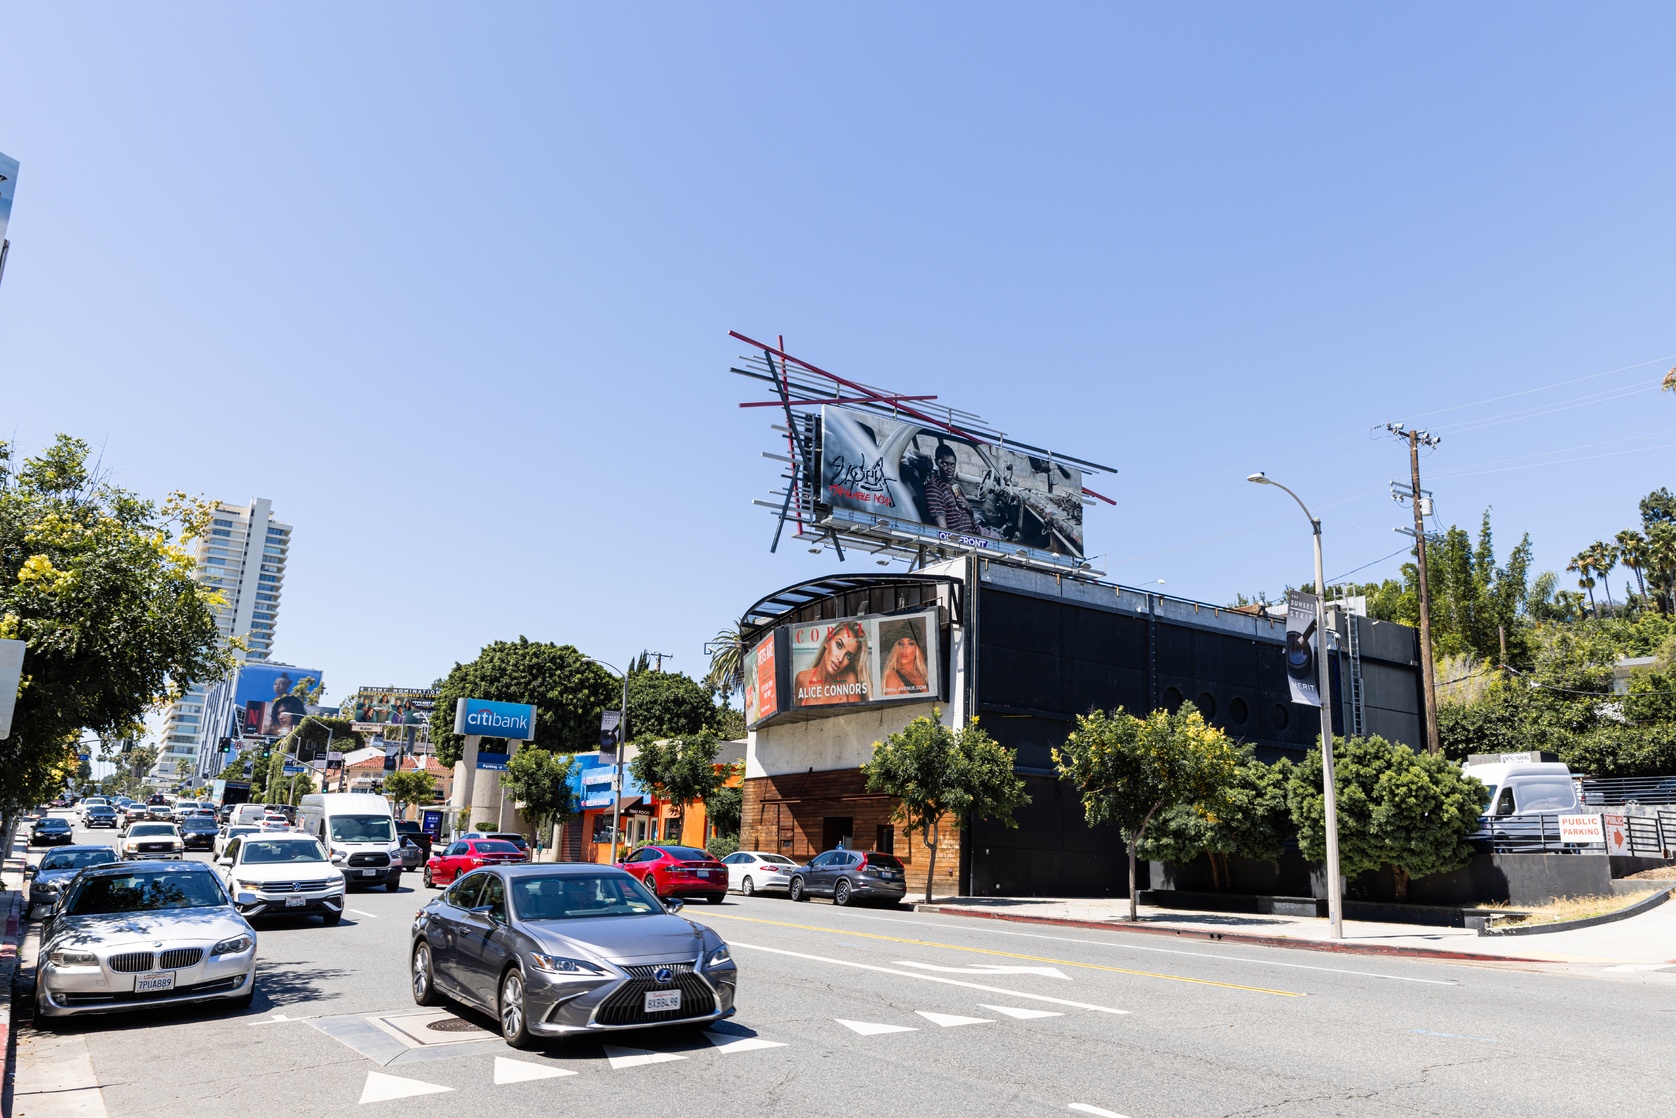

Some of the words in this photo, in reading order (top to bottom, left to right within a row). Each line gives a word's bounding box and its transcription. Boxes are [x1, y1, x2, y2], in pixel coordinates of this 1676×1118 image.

[873, 493, 893, 507] NOW
[939, 532, 987, 548] OFRONT
[1290, 599, 1314, 611] SUNSET
[1289, 610, 1313, 621] STRIP
[798, 686, 823, 699] ALICE
[824, 682, 868, 697] CONNORS
[1291, 682, 1315, 692] MERIT
[467, 709, 527, 729] citibank
[1562, 818, 1598, 826] PUBLIC
[1606, 816, 1623, 825] PUBLIC
[1563, 828, 1600, 836] PARKING
[139, 979, 172, 989] 7PUA889
